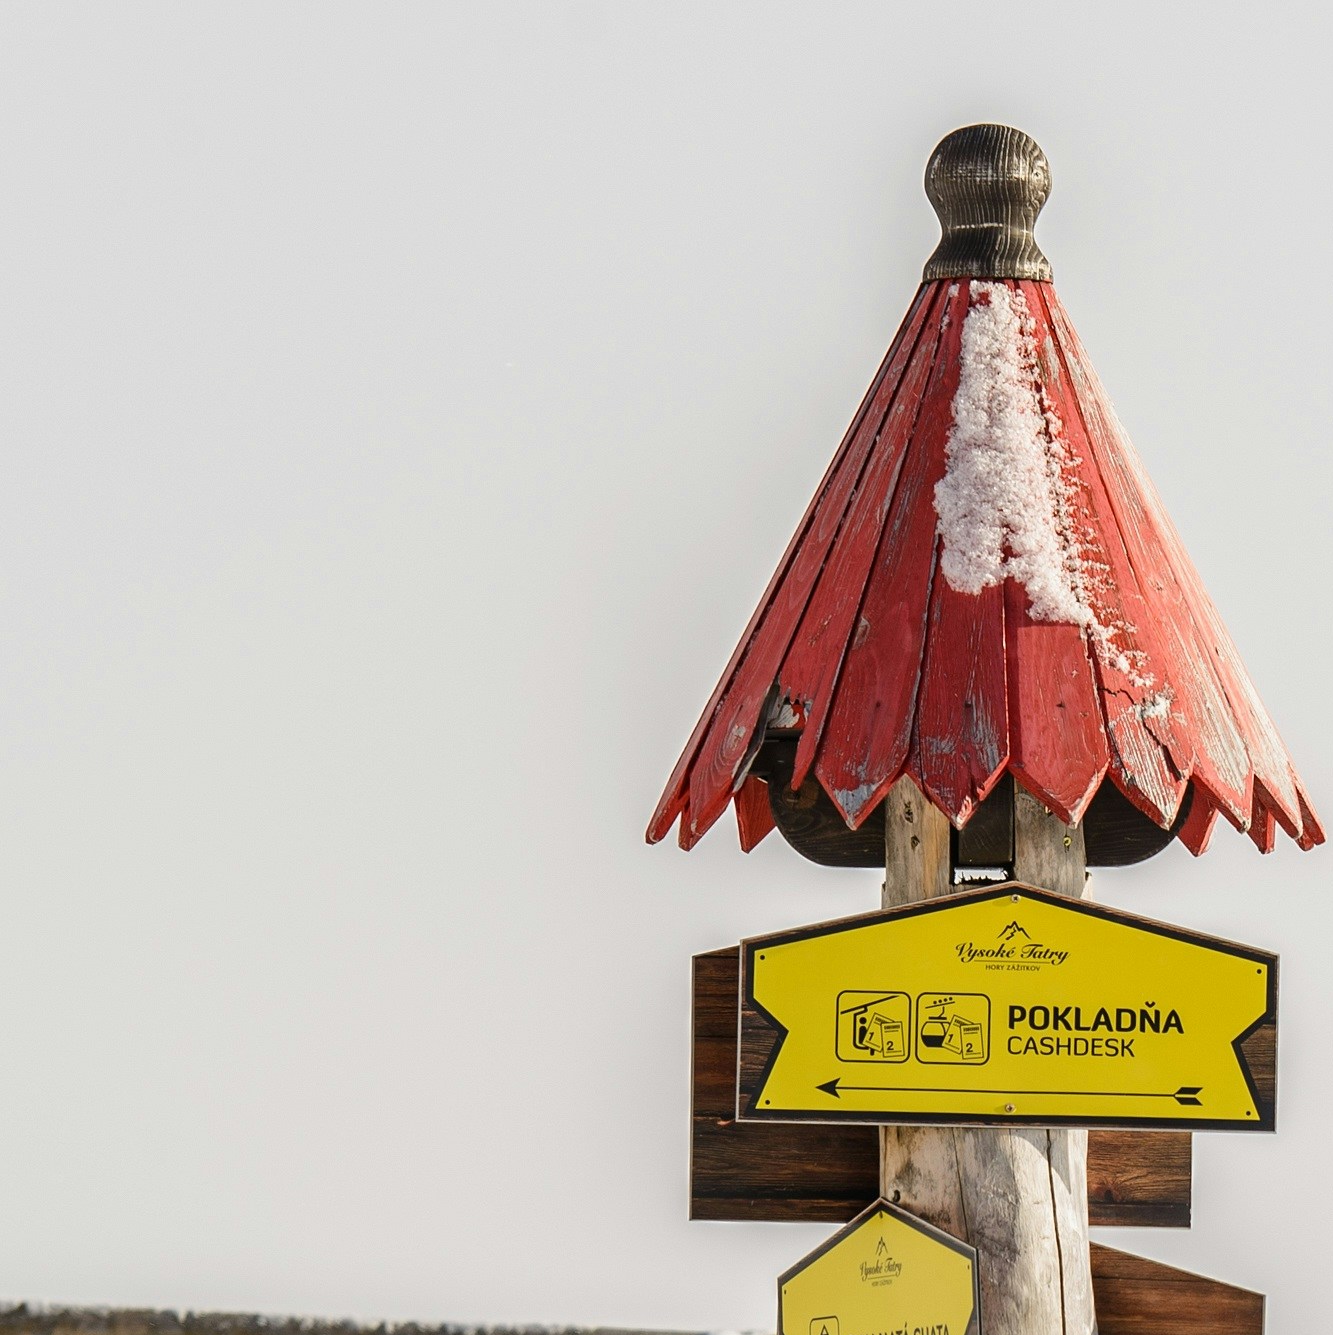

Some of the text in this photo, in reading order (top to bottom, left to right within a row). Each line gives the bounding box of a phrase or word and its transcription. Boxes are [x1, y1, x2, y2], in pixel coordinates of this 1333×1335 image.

[955, 942, 1069, 965] Vysoké Tatry
[1008, 1001, 1184, 1034] POKLADŇA
[868, 1031, 875, 1041] 1
[947, 1033, 954, 1043] 1
[886, 1041, 894, 1051] 2
[965, 1042, 973, 1052] 2
[1007, 1035, 1135, 1057] CASHDESK
